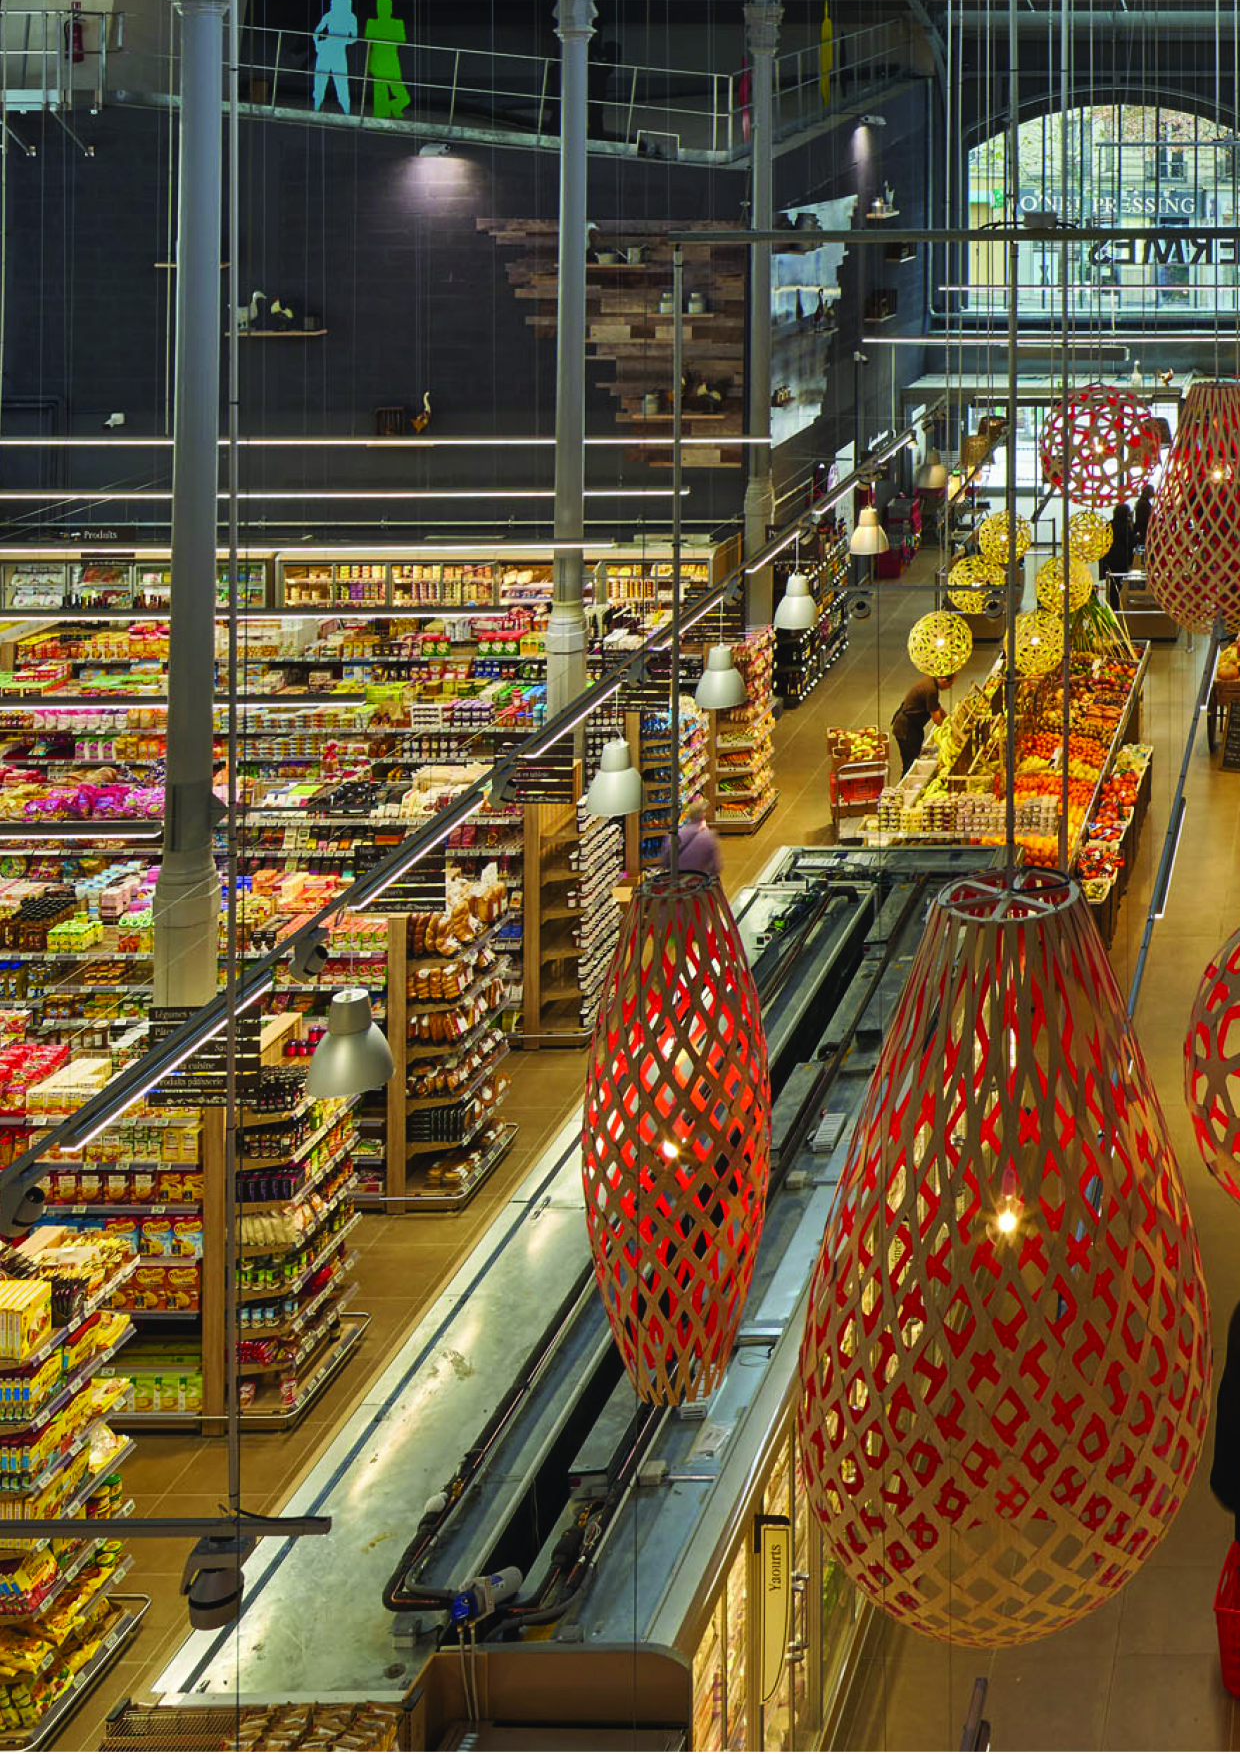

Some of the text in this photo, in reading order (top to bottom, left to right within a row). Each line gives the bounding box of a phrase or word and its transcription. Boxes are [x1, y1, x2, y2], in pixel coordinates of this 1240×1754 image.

[1092, 196, 1196, 215] PRESSING
[84, 530, 118, 540] Produits
[768, 1544, 782, 1592] Yaourts
